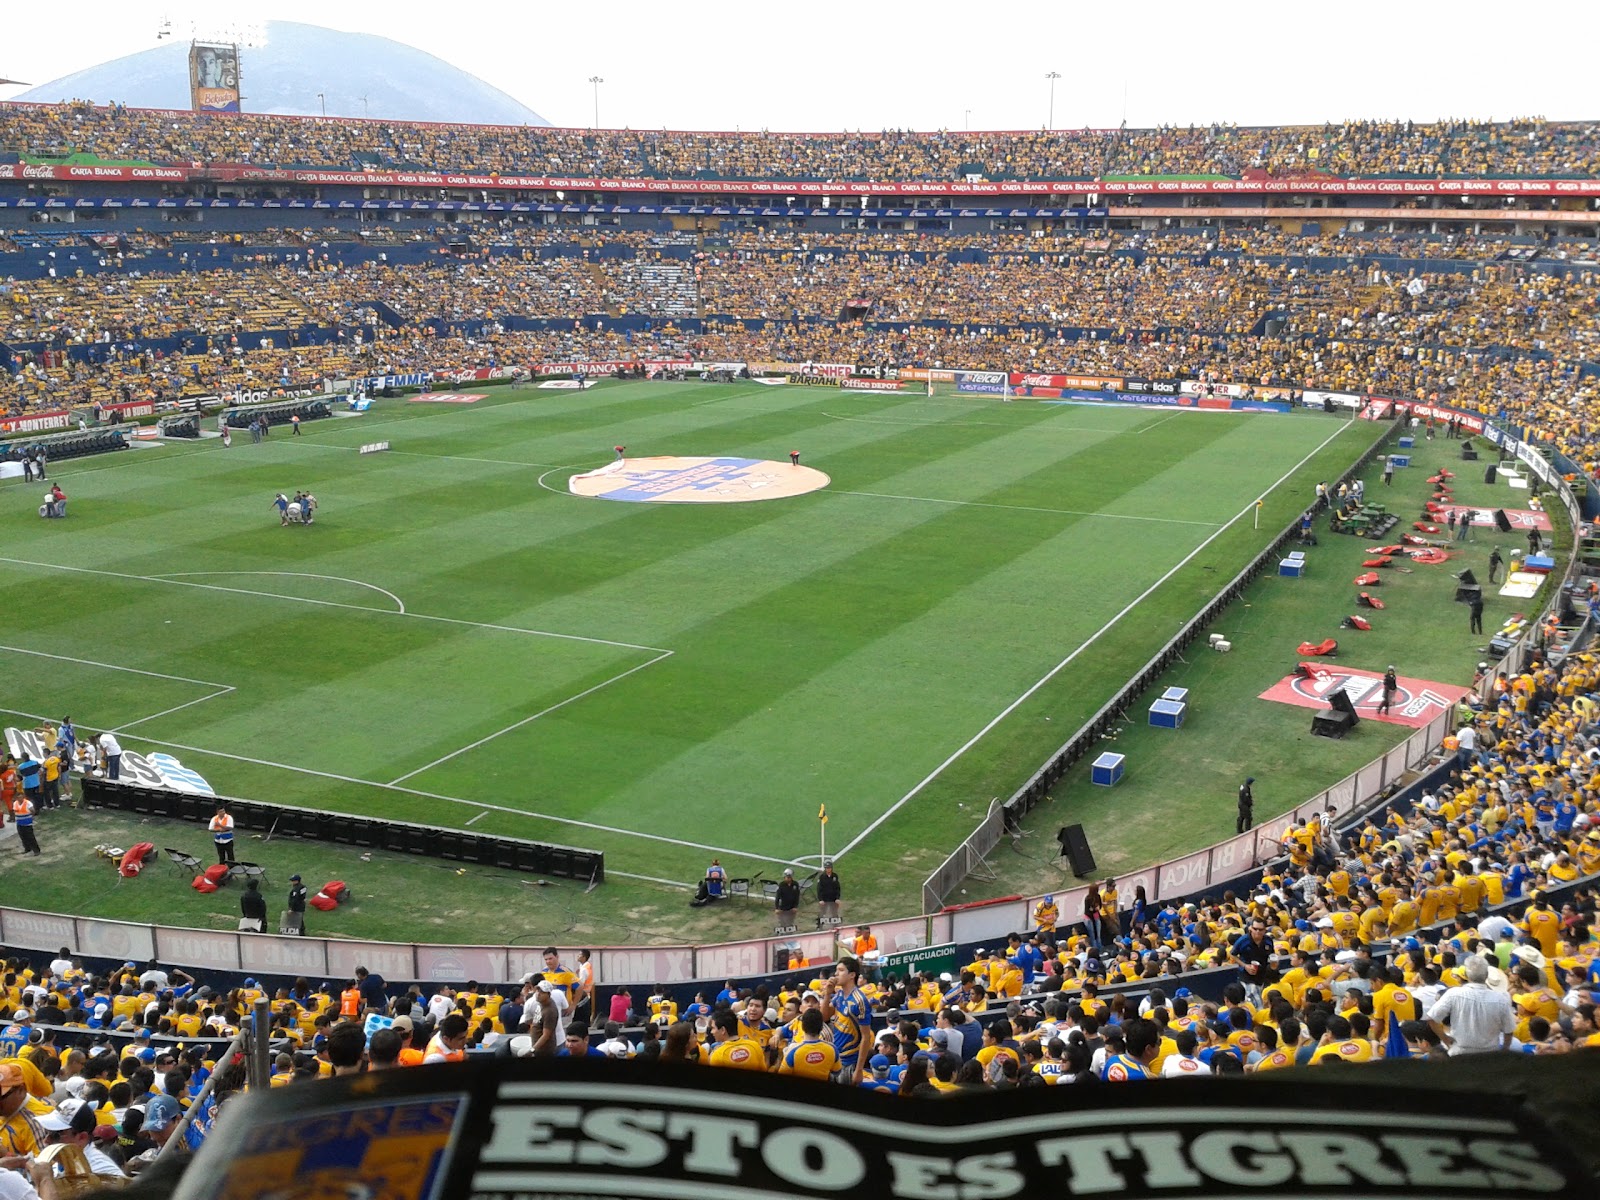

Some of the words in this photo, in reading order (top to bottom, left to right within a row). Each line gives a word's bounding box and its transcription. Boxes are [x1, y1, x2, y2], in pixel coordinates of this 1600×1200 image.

[70, 167, 92, 175] CARTA
[95, 168, 122, 176] BLANCA
[132, 168, 153, 176] CARTA
[155, 169, 182, 177] BLANCA
[296, 173, 318, 181] CARTA
[345, 174, 366, 182] CARTA
[368, 174, 393, 182] BLANCA
[419, 175, 442, 183] BLANCA
[469, 177, 493, 185] BLANCA
[549, 179, 569, 187] CARTA
[600, 180, 620, 188] CARTA
[622, 181, 646, 189] BLANCA
[648, 182, 670, 190] CARTA
[700, 183, 722, 191] CARTA
[723, 183, 749, 191] BLANCA
[801, 183, 821, 191] CARTA
[1158, 182, 1179, 190] CARTA
[1181, 182, 1207, 190] BLANCA
[1212, 182, 1233, 190] CARTA
[1235, 182, 1262, 190] BLANCA
[1265, 182, 1287, 190] CARTA
[1290, 182, 1319, 190] BLANCA
[1321, 182, 1344, 190] CARTA
[1347, 182, 1376, 190] BLANCA
[1378, 182, 1402, 190] CARTA
[1404, 183, 1434, 191] BLANCA
[1439, 182, 1462, 190] CARTA
[1464, 182, 1492, 190] BLANCA
[1497, 182, 1520, 190] CARTA
[1522, 182, 1551, 190] BLANCA
[1556, 182, 1578, 190] CARTA
[541, 365, 573, 374] CARTA
[577, 364, 618, 374] BLANCA
[789, 375, 838, 386] BARDAHL
[842, 379, 871, 389] Office
[871, 381, 898, 390] DEPOT
[19, 414, 69, 432] MONTERREY
[890, 956, 902, 967] DE
[902, 947, 956, 964] EVACUACION
[480, 1104, 866, 1191] ESTO
[887, 1150, 1025, 1200] ES
[1038, 1130, 1568, 1195] TIGRES
